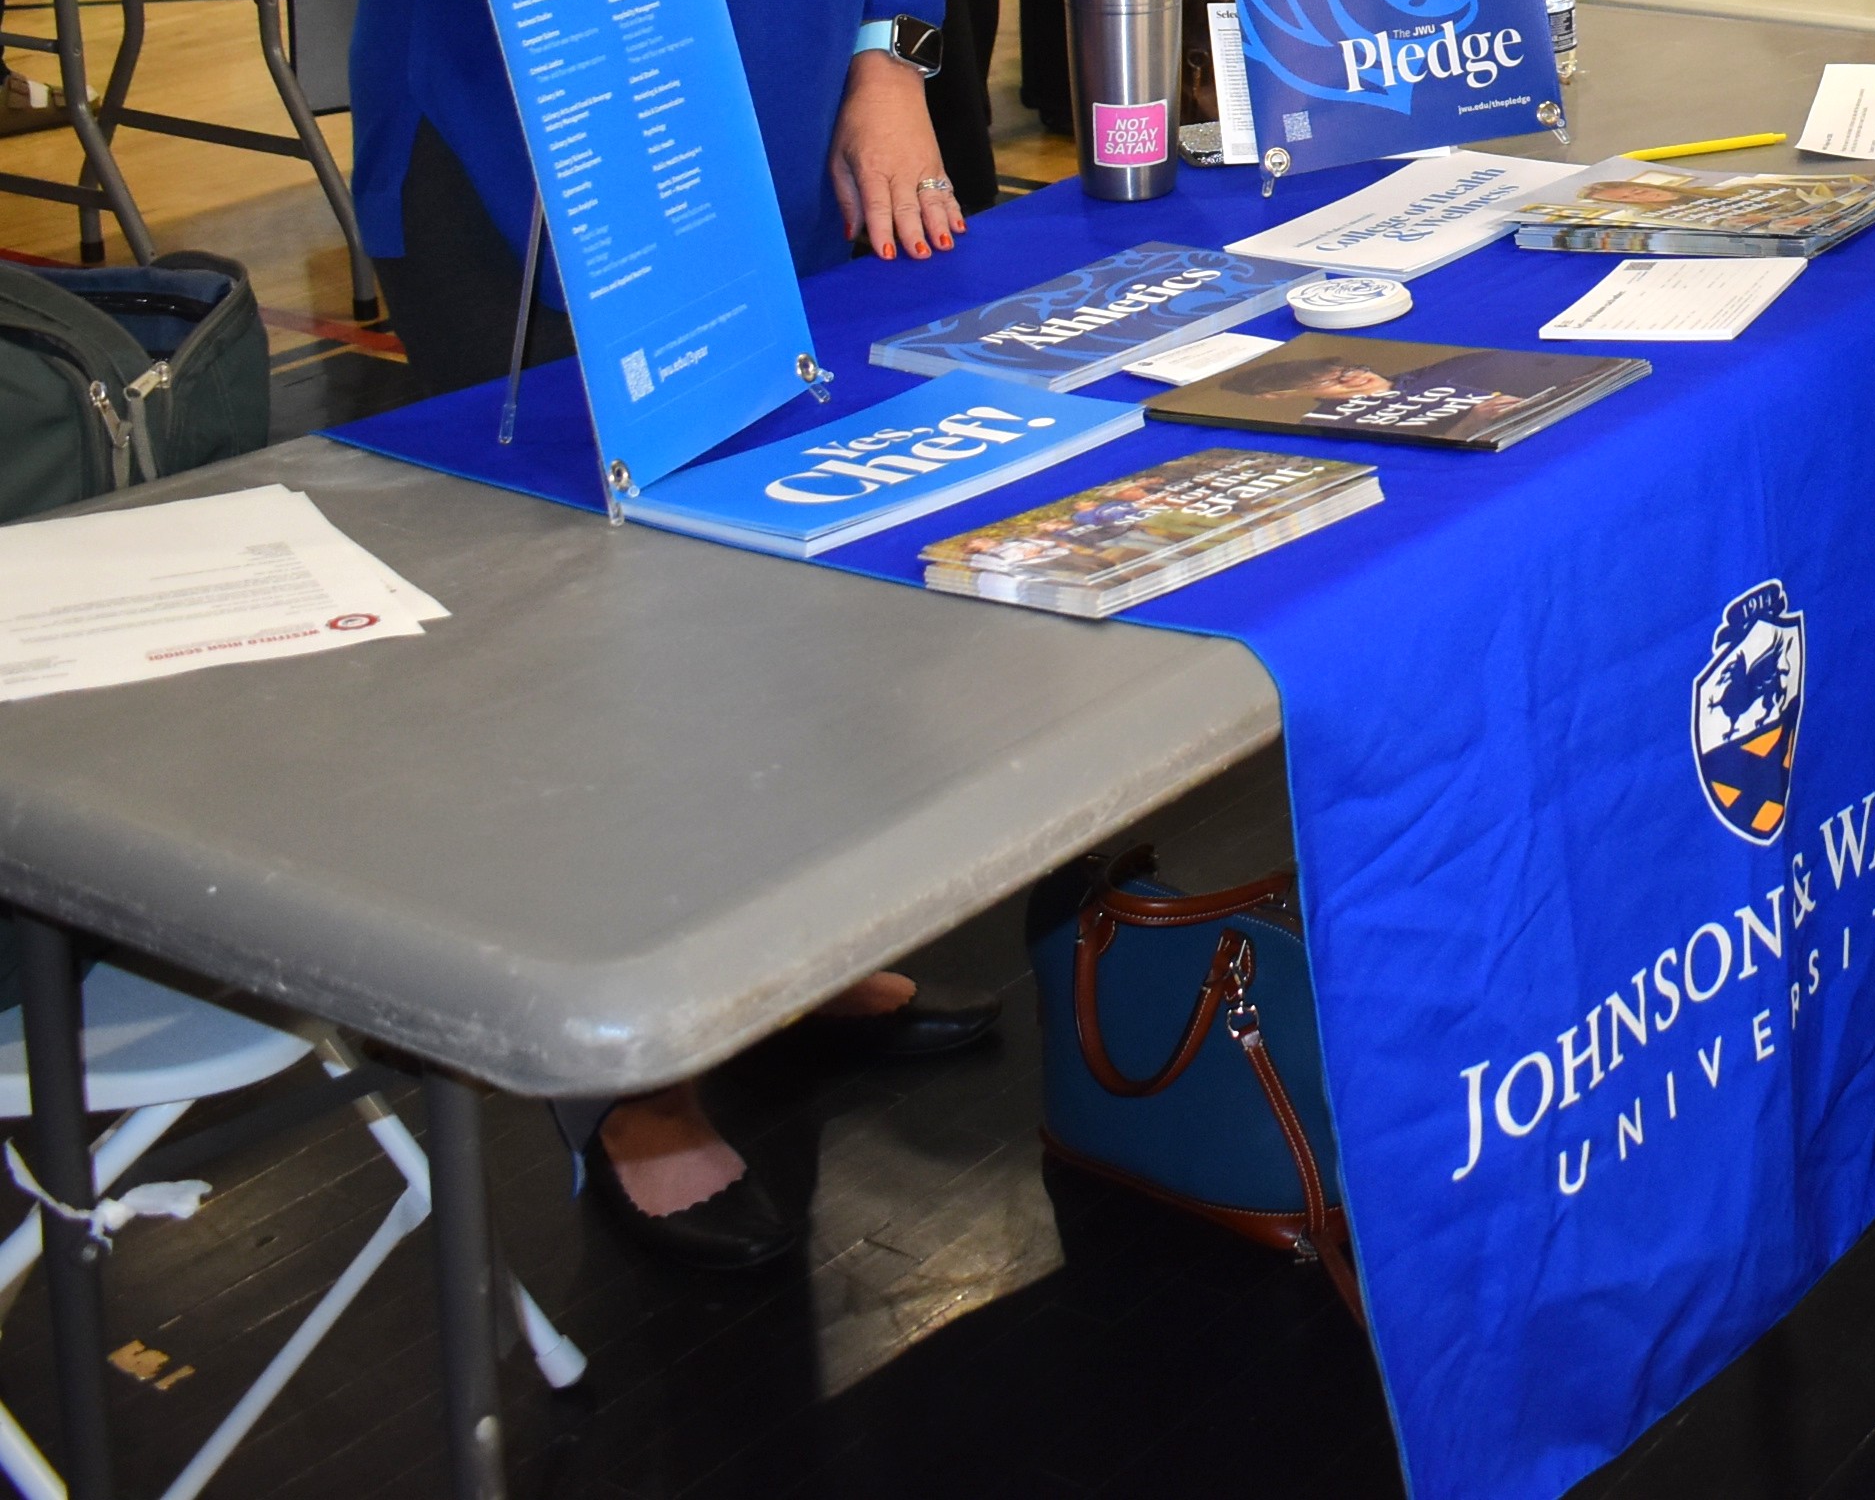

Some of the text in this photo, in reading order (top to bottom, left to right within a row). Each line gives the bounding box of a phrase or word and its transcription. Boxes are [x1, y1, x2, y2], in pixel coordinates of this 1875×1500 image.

[1393, 23, 1437, 40] The JWU
[1337, 19, 1527, 95] Pledge
[1457, 95, 1531, 115] jwu.edu/thepledge
[1106, 127, 1158, 144] TODAY
[1115, 116, 1150, 131] NOT
[1103, 141, 1158, 155] SATAN.
[1315, 213, 1411, 251] College
[1404, 197, 1431, 216] of
[1421, 166, 1507, 206] Health
[1382, 227, 1436, 243] &
[1411, 184, 1520, 229] Wellness
[1008, 265, 1223, 353] Athletics
[979, 319, 1041, 346] JWU
[1303, 389, 1400, 421] Let's
[1355, 385, 1457, 426] get to
[764, 406, 1059, 505] Chef!
[802, 427, 937, 462] Yes,
[1166, 486, 1214, 505] for
[1210, 468, 1263, 488] the
[1180, 464, 1327, 519] grant.
[1741, 592, 1774, 619] 1914
[1451, 884, 1786, 1181] JOHNSON
[1791, 851, 1817, 930] &
